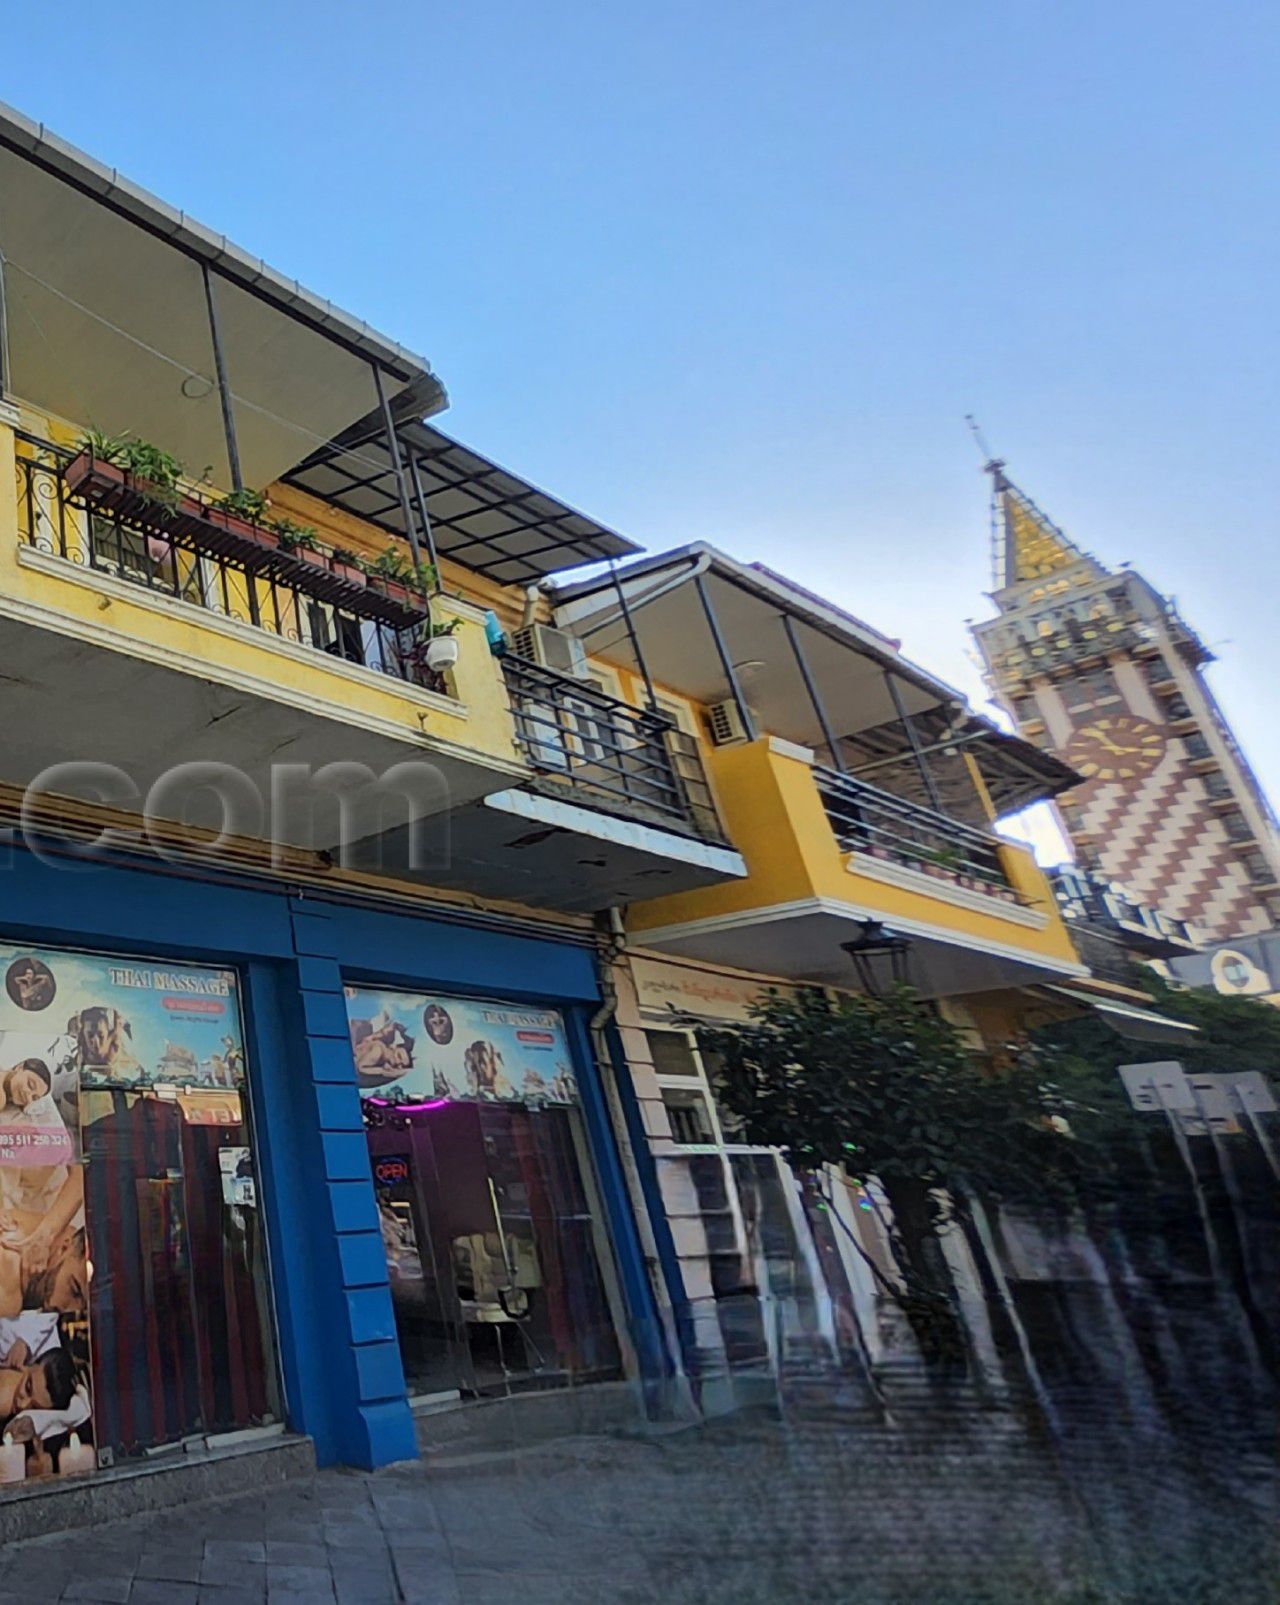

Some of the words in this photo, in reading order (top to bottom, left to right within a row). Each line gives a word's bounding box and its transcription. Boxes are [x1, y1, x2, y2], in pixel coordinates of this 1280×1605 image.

[108, 968, 152, 988] THAI
[153, 972, 230, 996] MASSAGE
[376, 1163, 408, 1181] OPEN
